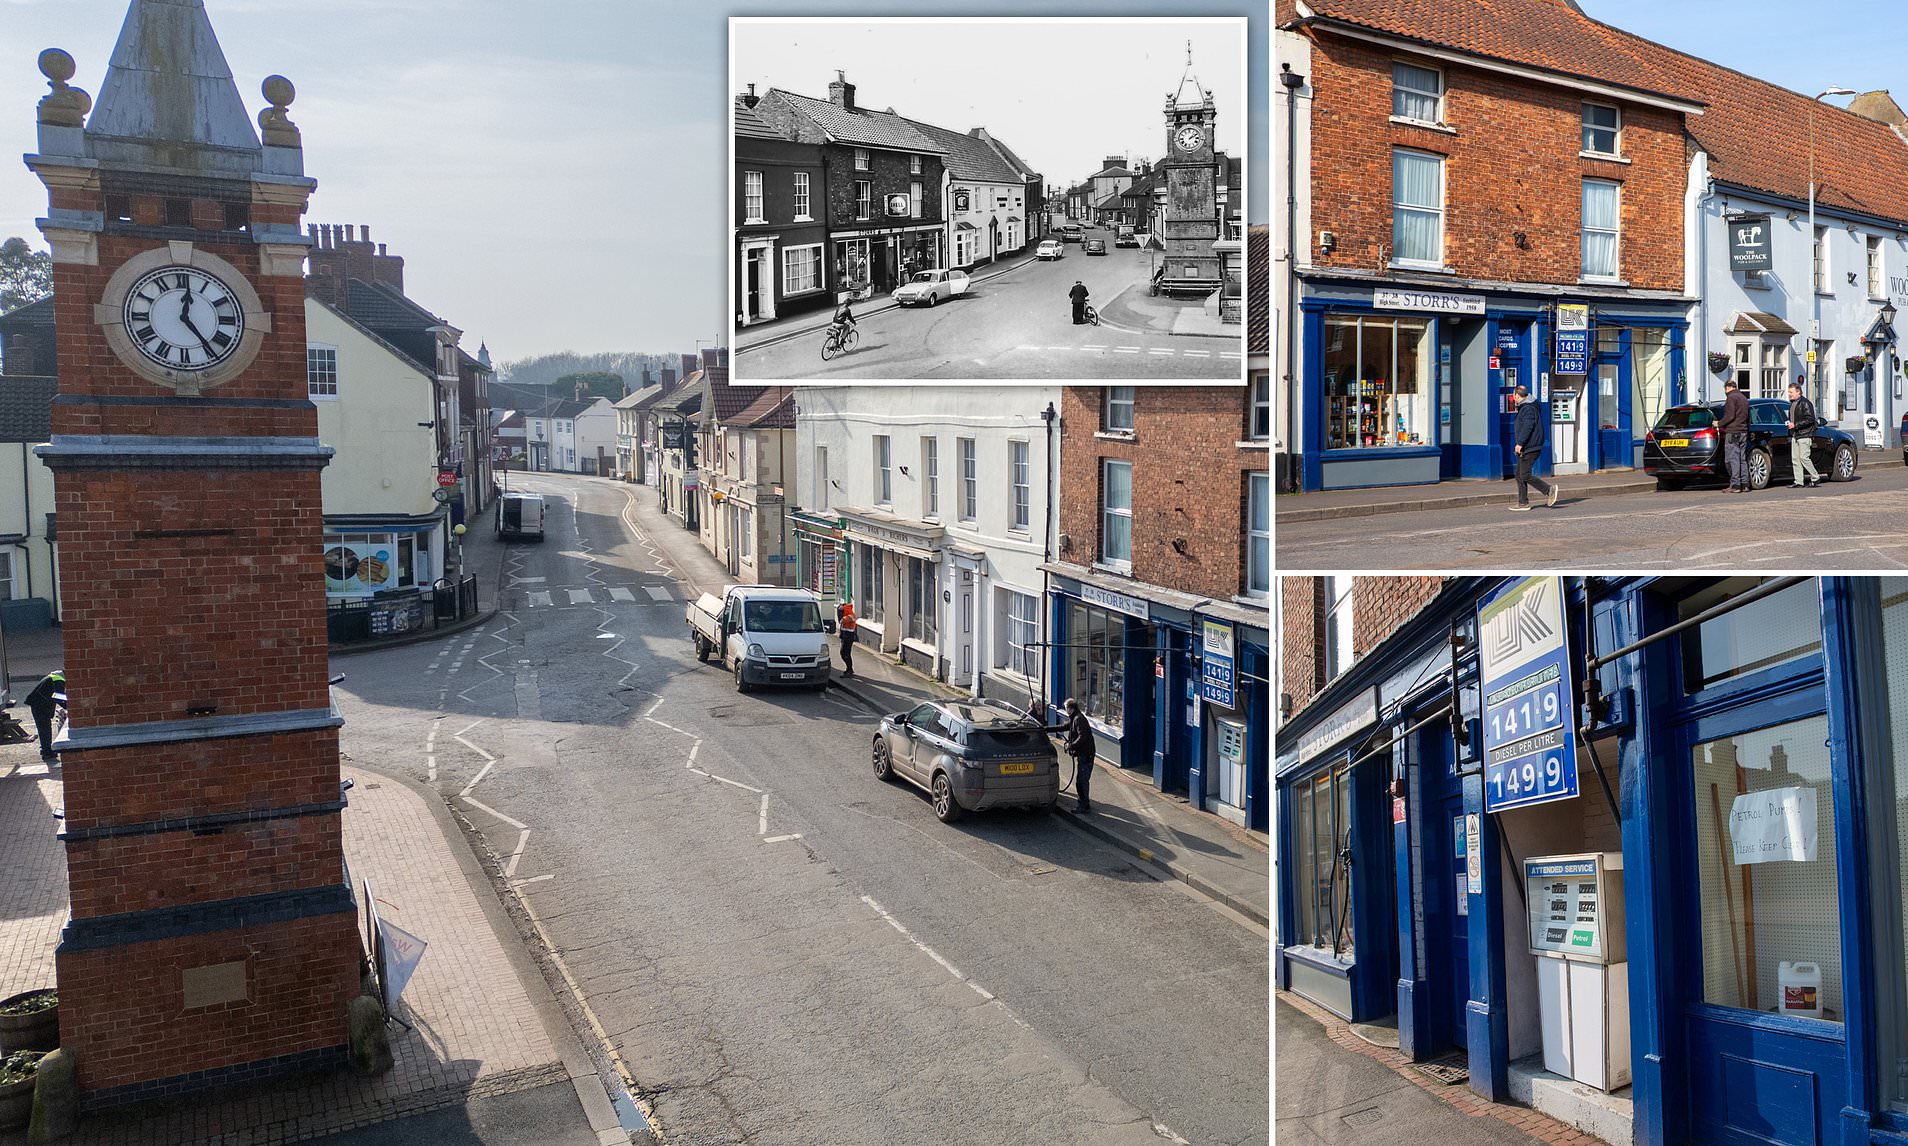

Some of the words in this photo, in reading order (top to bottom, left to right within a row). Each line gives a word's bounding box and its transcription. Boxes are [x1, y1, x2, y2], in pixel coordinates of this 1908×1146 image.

[1403, 292, 1460, 310] STORR'S
[1096, 590, 1131, 610] STORR'S
[1495, 748, 1517, 760] DIESEL
[1519, 741, 1533, 752] PER
[1534, 733, 1555, 749] LITRE
[1731, 809, 1763, 822] PETROL
[1759, 838, 1778, 852] KEEP
[1531, 865, 1563, 874] ATTENDED
[1564, 863, 1594, 873] SERVICE
[1573, 934, 1589, 942] Petrol
